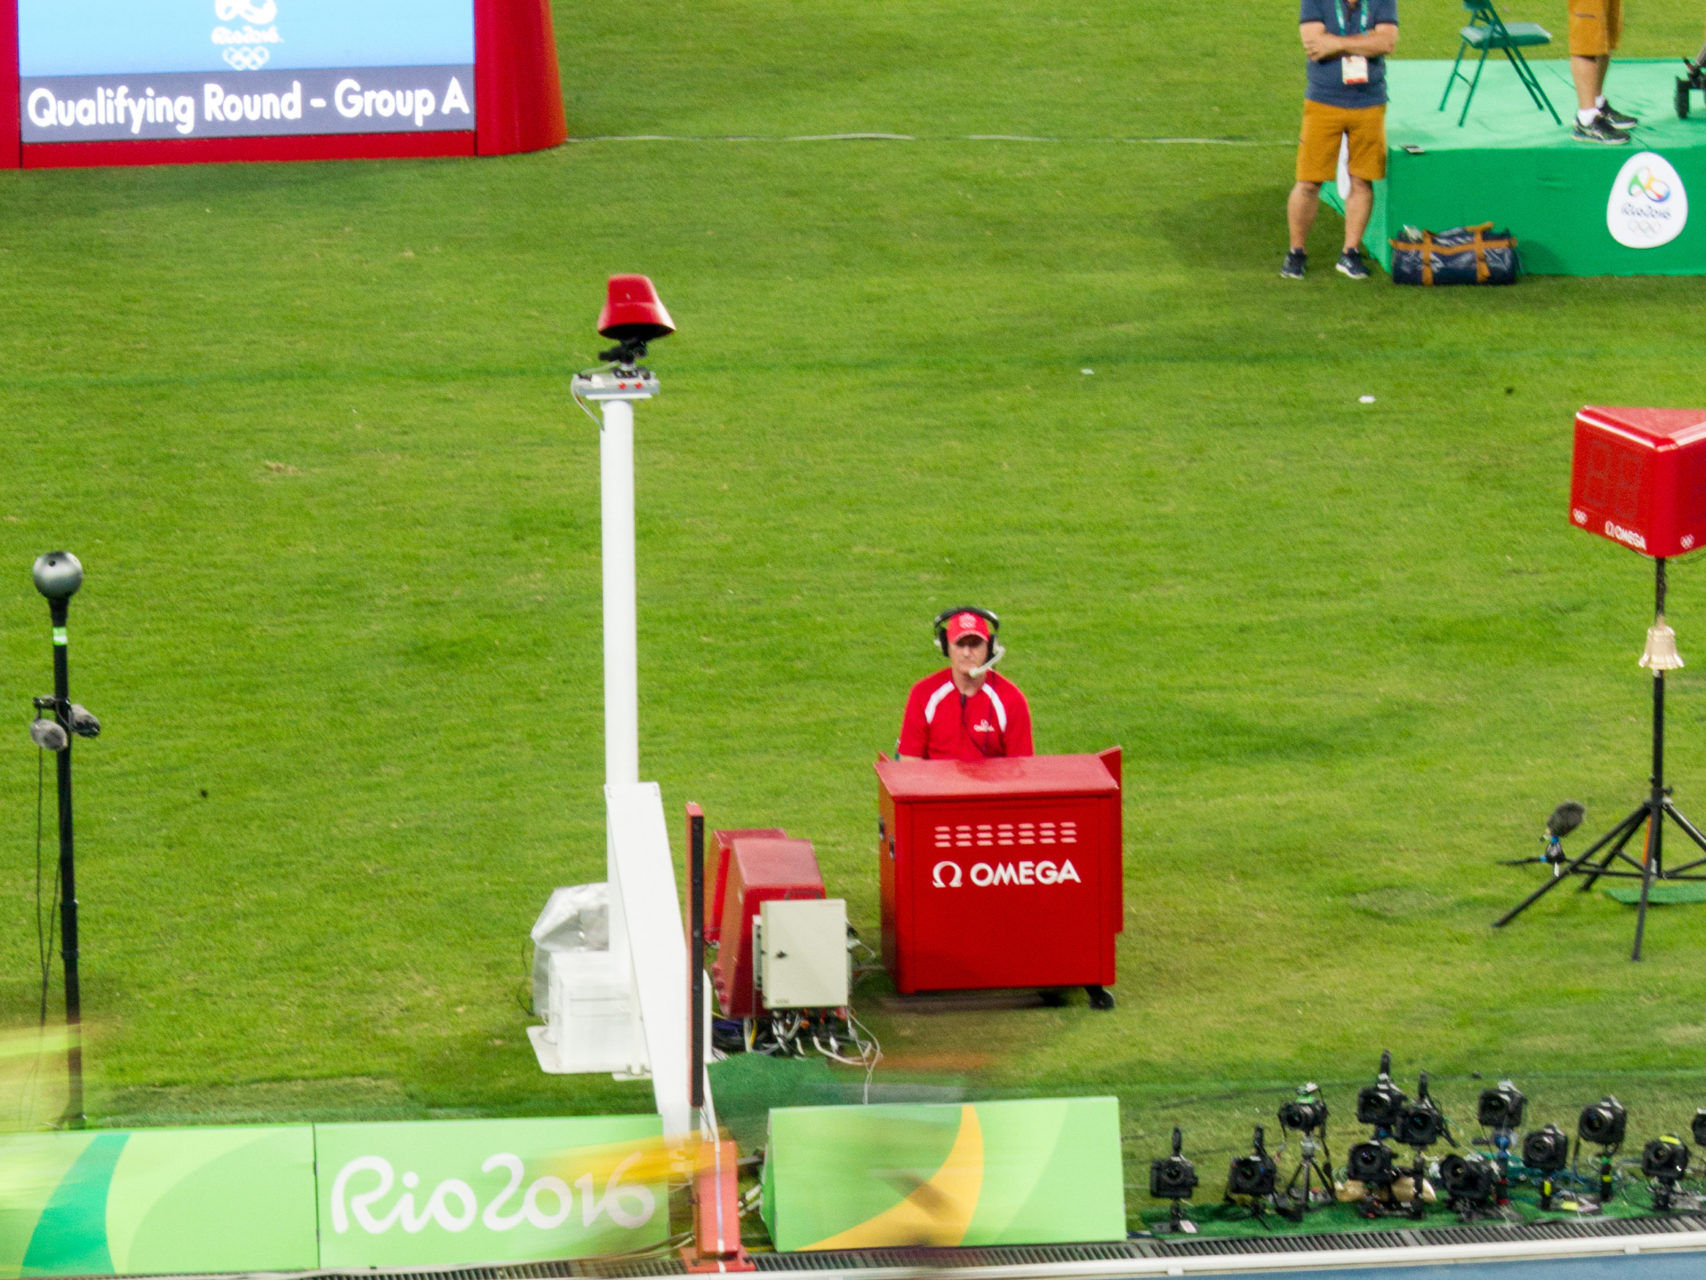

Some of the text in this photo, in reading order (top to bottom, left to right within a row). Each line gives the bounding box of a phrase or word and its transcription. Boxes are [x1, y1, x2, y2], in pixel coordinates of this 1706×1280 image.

[27, 86, 196, 135] Qualifying
[203, 80, 302, 122] Round
[333, 78, 436, 127] Group
[441, 76, 471, 115] A
[970, 858, 1081, 887] OMEGA
